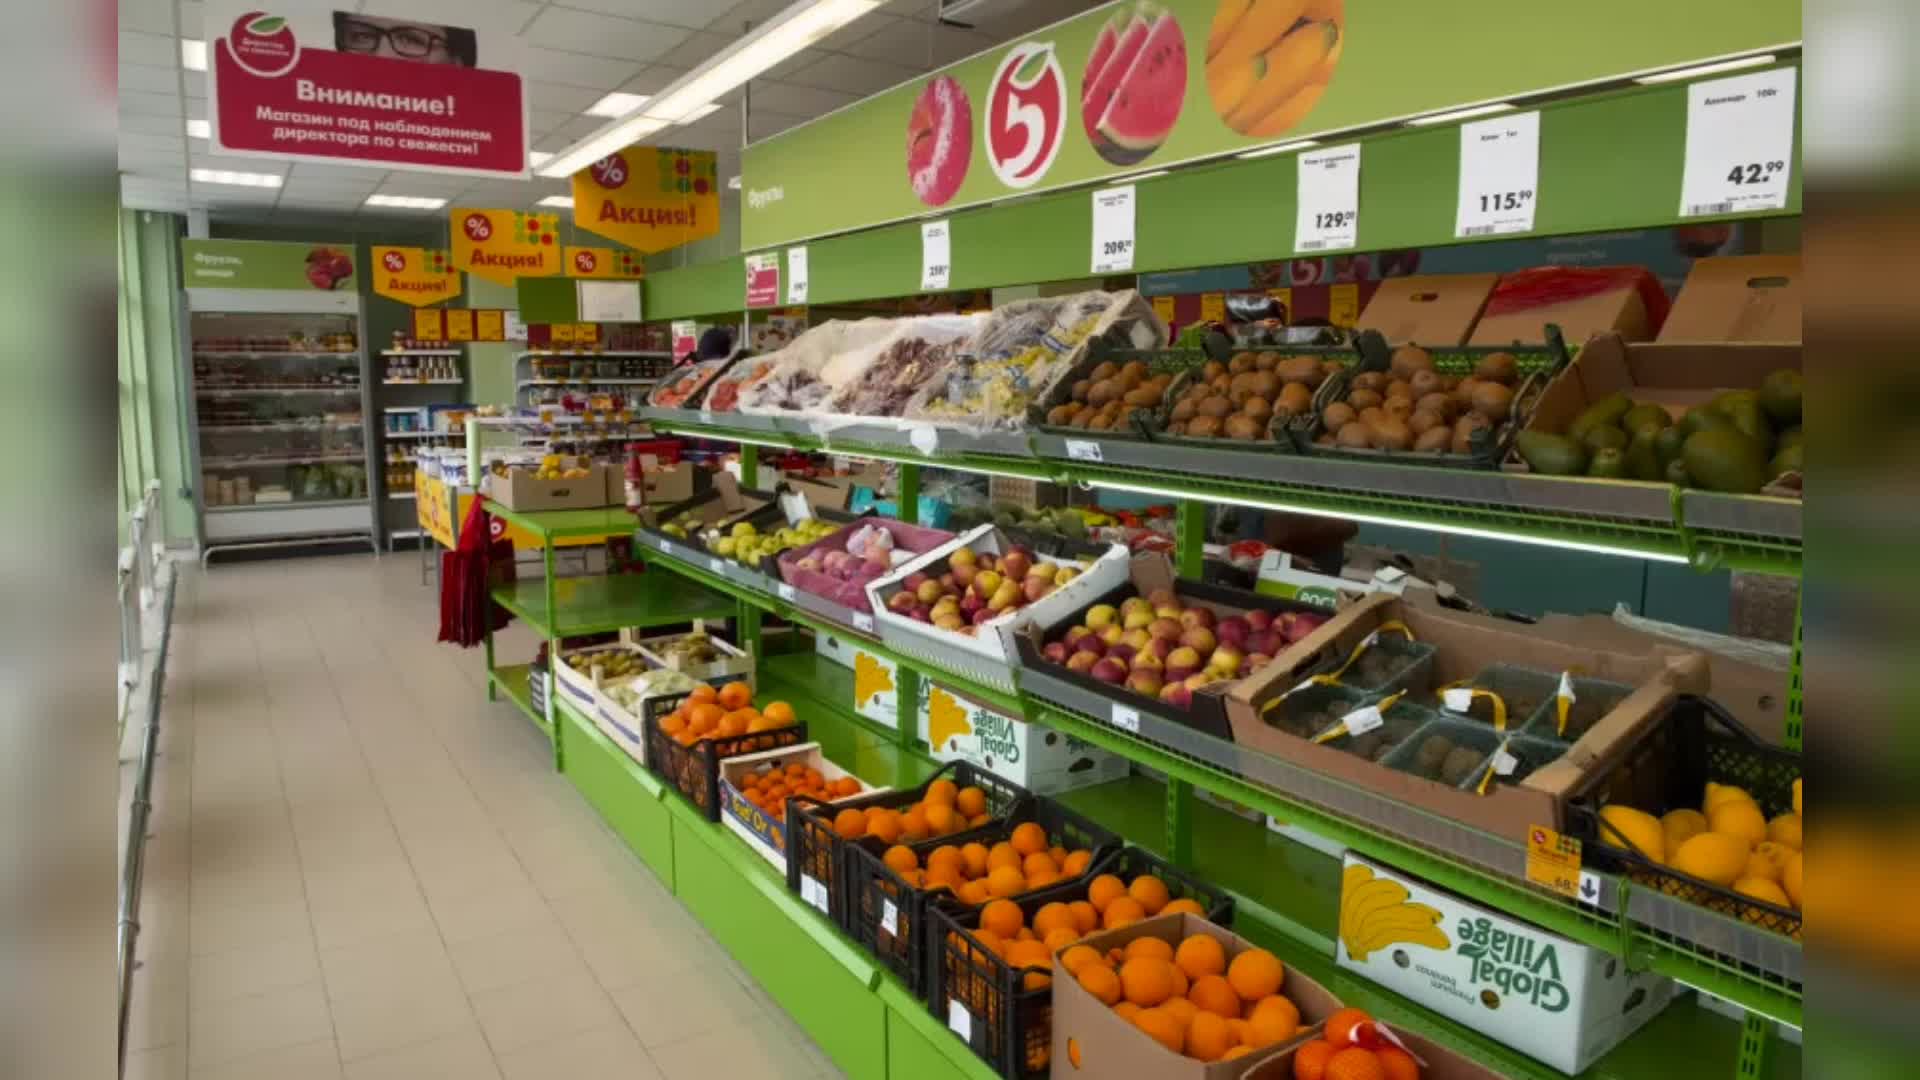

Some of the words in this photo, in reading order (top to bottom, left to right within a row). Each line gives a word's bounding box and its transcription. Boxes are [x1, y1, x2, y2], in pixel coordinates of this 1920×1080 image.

[296, 79, 456, 117] Внимание!
[256, 105, 333, 126] Магазин
[337, 117, 370, 131] под
[374, 120, 492, 142] наблюдением
[272, 127, 369, 147] директора
[374, 135, 394, 148] по
[398, 138, 479, 155] свежести!
[1727, 160, 1784, 185] 42.99
[598, 200, 696, 229] Акция!
[470, 248, 543, 269] Акция!
[389, 278, 448, 293] Акция!
[973, 708, 1015, 743] Village
[975, 730, 1019, 763] Global
[1457, 917, 1562, 981] Village
[1460, 947, 1570, 1012] Global
